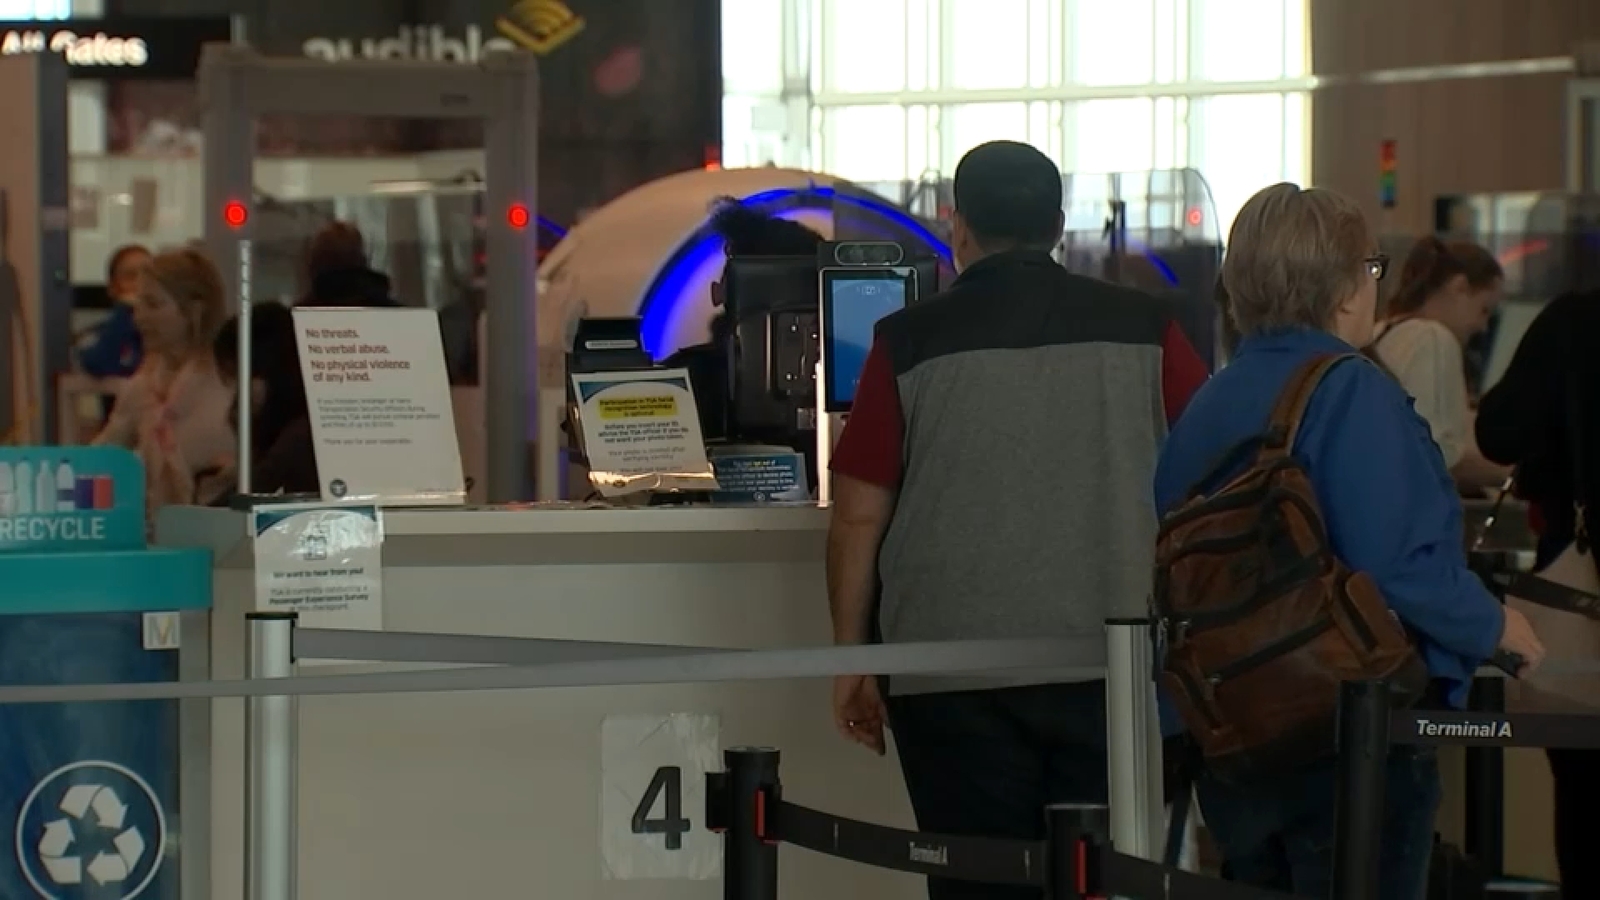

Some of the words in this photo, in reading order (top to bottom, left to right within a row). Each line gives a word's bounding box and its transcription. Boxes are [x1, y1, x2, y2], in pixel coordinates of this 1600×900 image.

[306, 329, 319, 339] No
[322, 329, 359, 339] threats.
[308, 345, 323, 354] No
[325, 344, 357, 354] verbal
[359, 344, 390, 354] abuse.
[311, 360, 325, 370] No
[327, 360, 367, 371] physical
[370, 360, 410, 370] violence
[313, 372, 323, 382] of
[326, 374, 344, 384] any
[346, 372, 371, 382] kind.
[0, 517, 106, 540] RECYCLE
[1416, 719, 1495, 738] Terminal
[1498, 721, 1513, 738] A
[632, 766, 691, 850] 4
